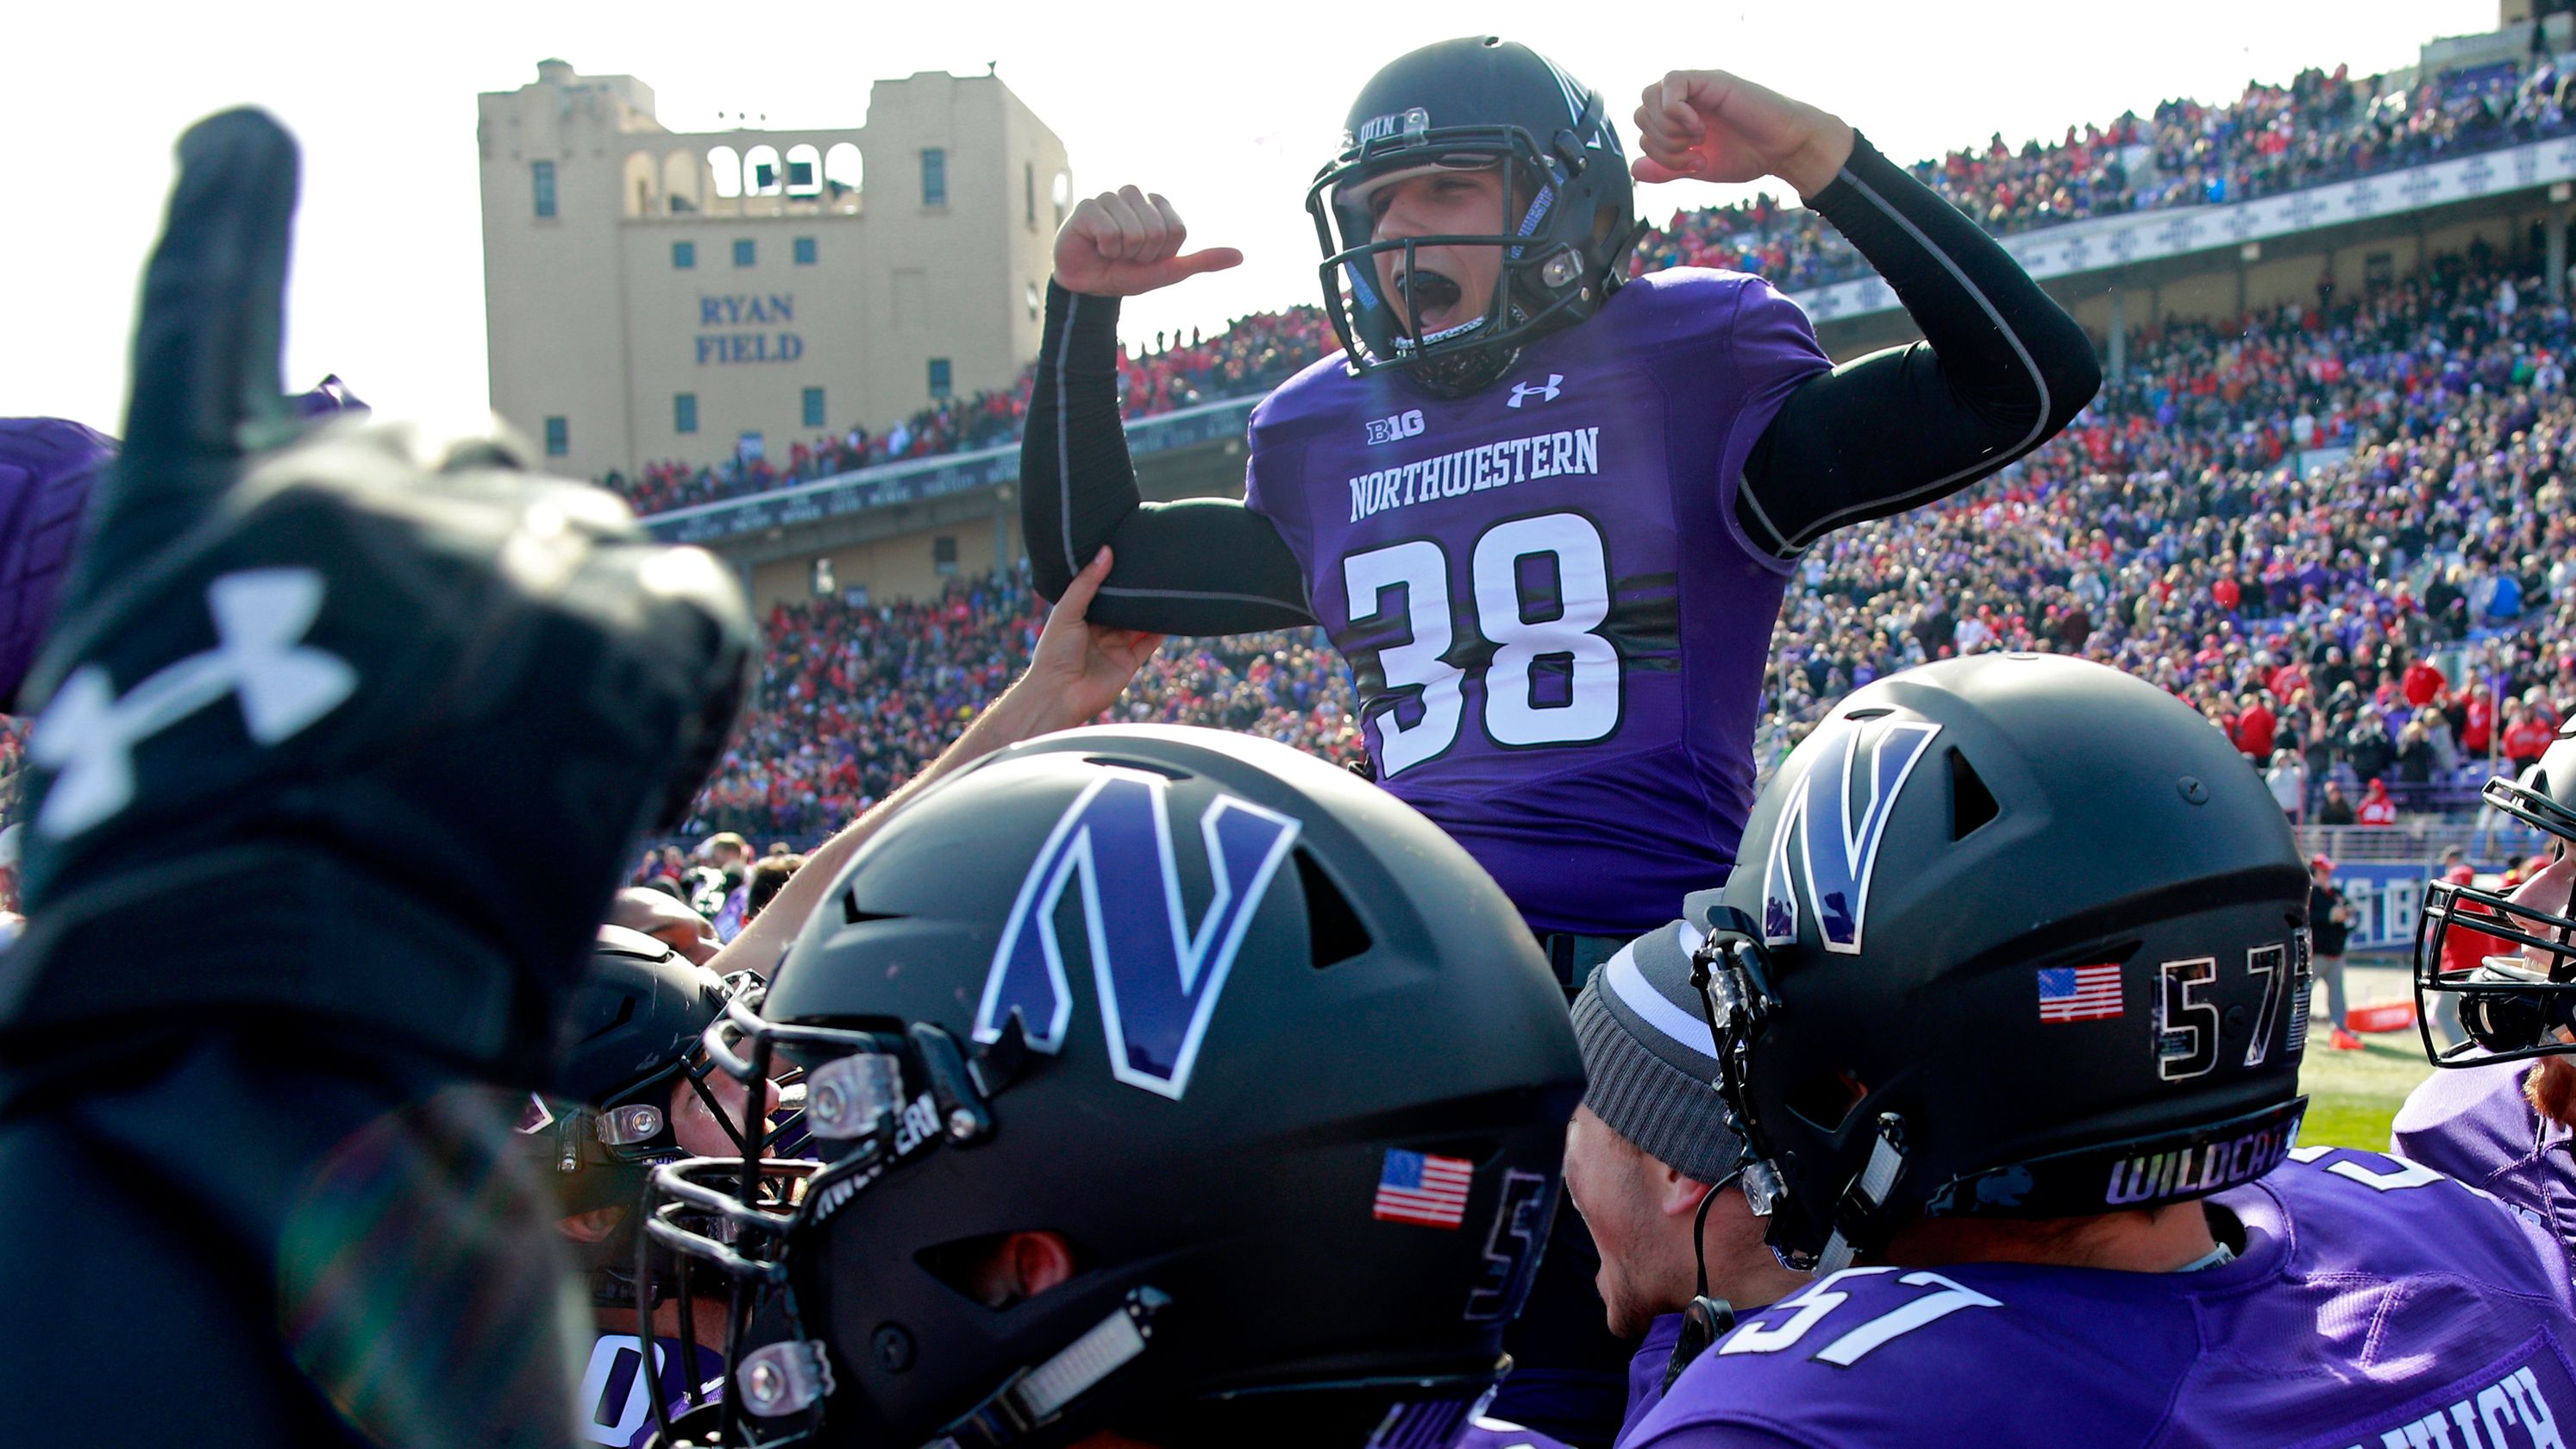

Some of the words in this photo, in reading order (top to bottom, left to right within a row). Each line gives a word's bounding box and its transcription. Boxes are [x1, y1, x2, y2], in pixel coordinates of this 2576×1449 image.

[695, 330, 804, 365] FIELD
[700, 292, 793, 324] RYAN
[1349, 426, 1600, 524] NORTHWESTERN
[1342, 511, 1621, 780] 38
[971, 764, 1304, 1102] N
[2158, 942, 2285, 1082] 57
[1718, 1266, 2005, 1367] 57
